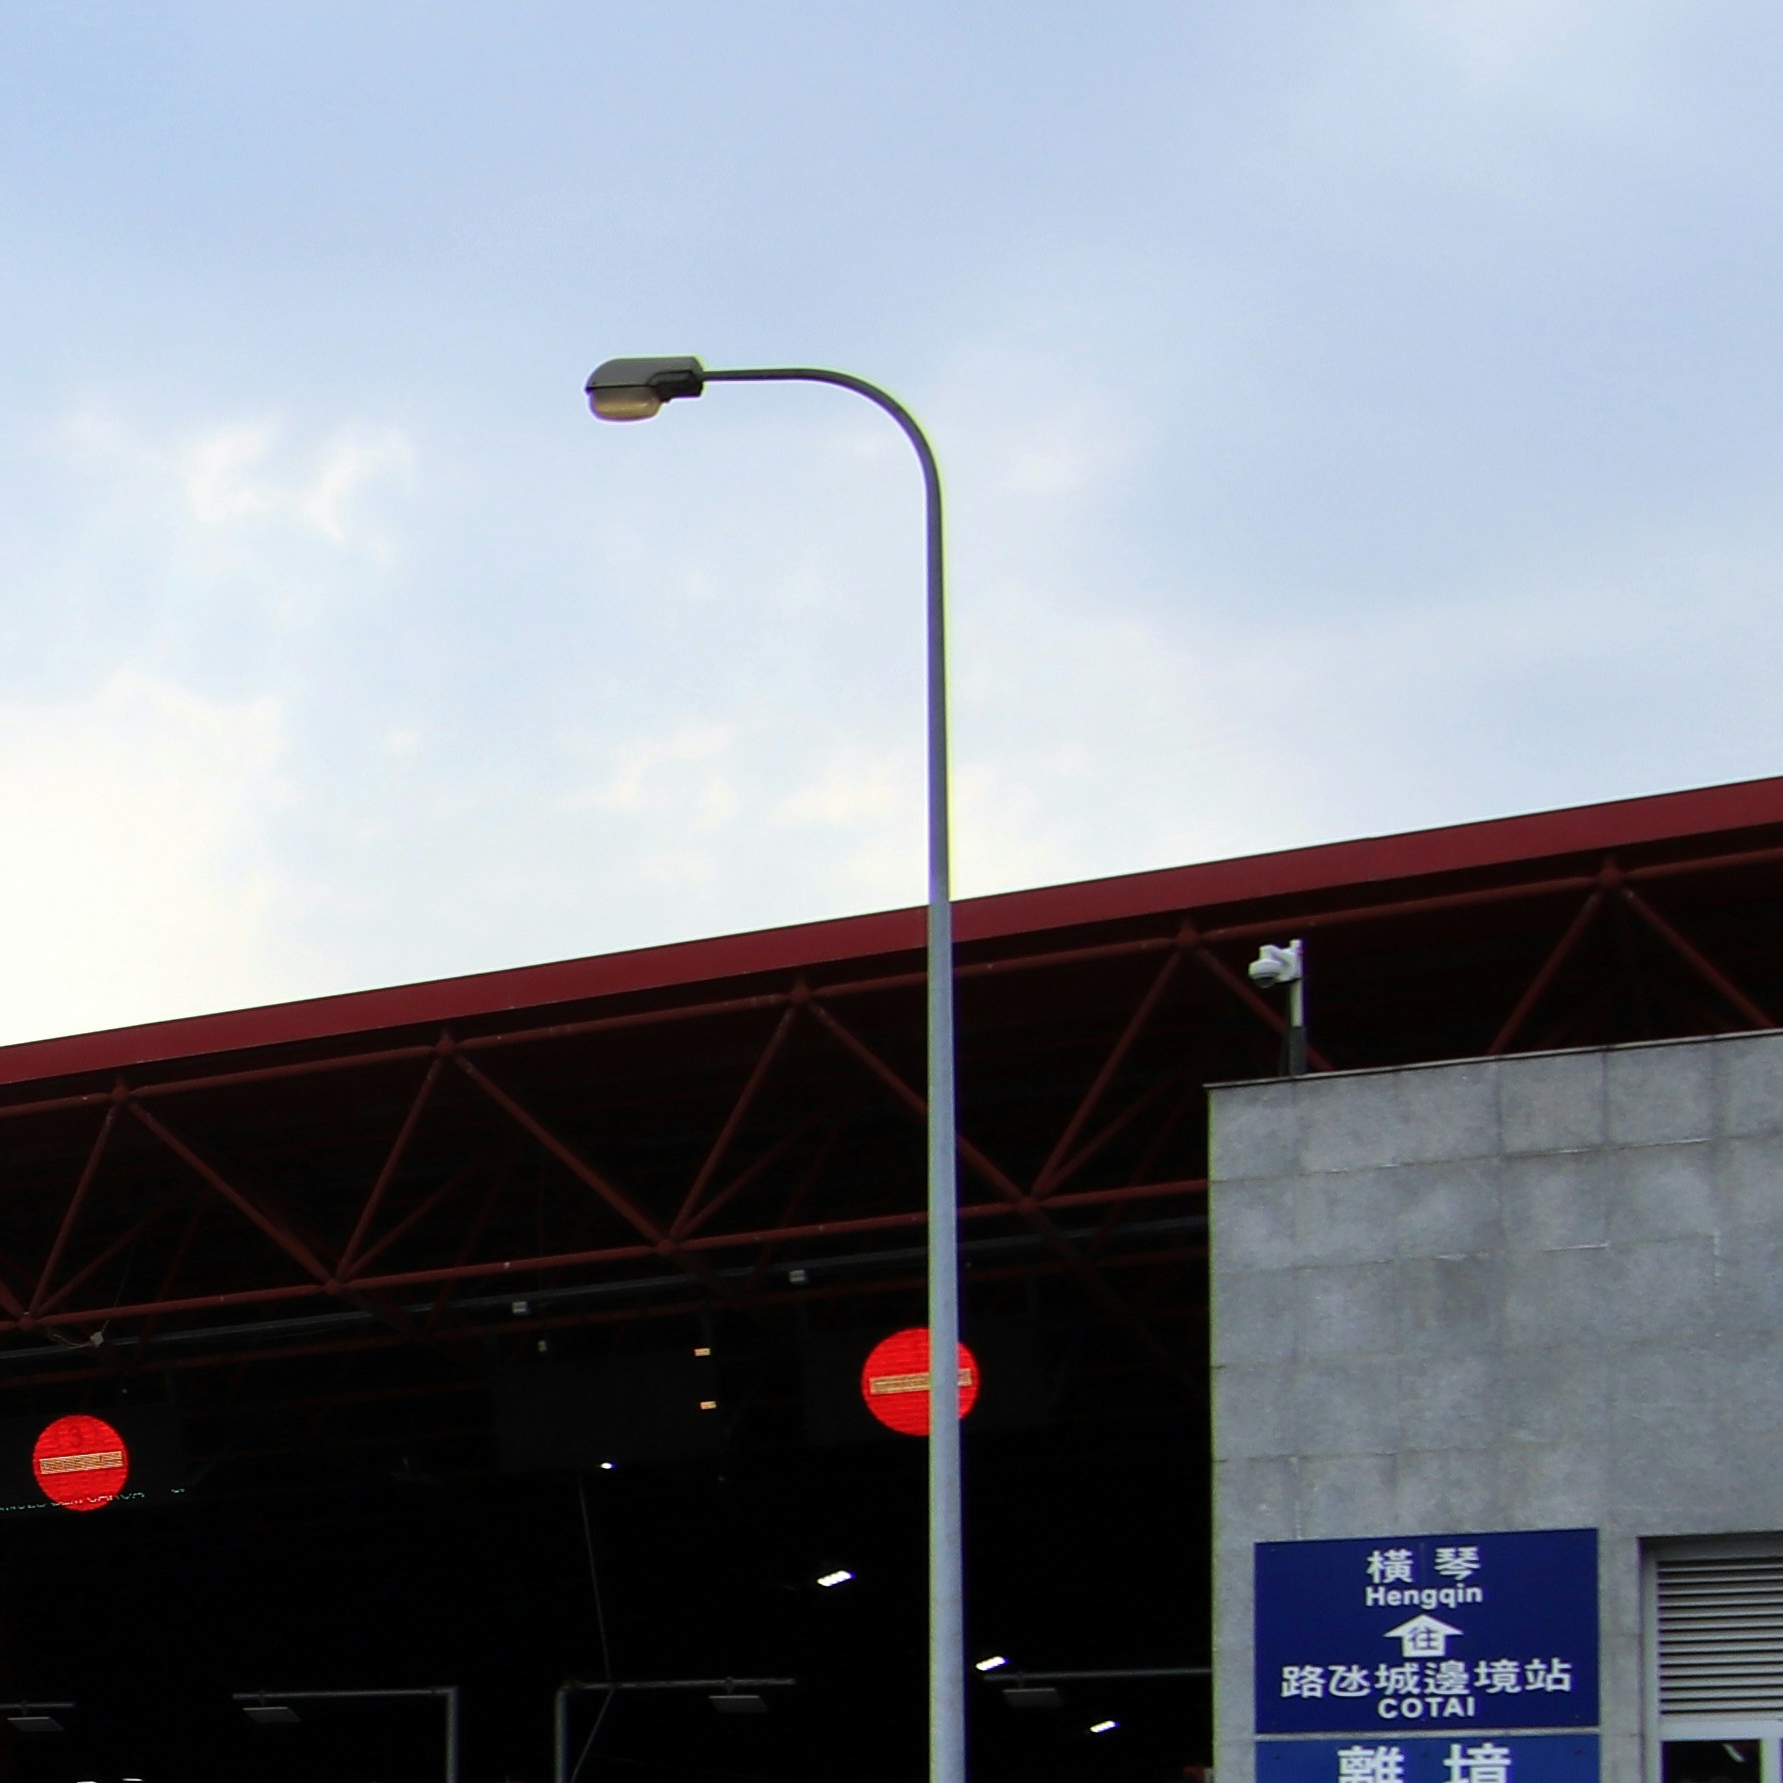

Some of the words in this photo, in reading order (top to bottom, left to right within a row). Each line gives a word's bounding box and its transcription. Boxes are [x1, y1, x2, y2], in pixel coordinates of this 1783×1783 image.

[1365, 1584, 1482, 1609] Hengqin
[1408, 1626, 1441, 1652] 往
[1281, 1658, 1572, 1698] 路氹城邊境站
[1377, 1697, 1475, 1719] COTAI
